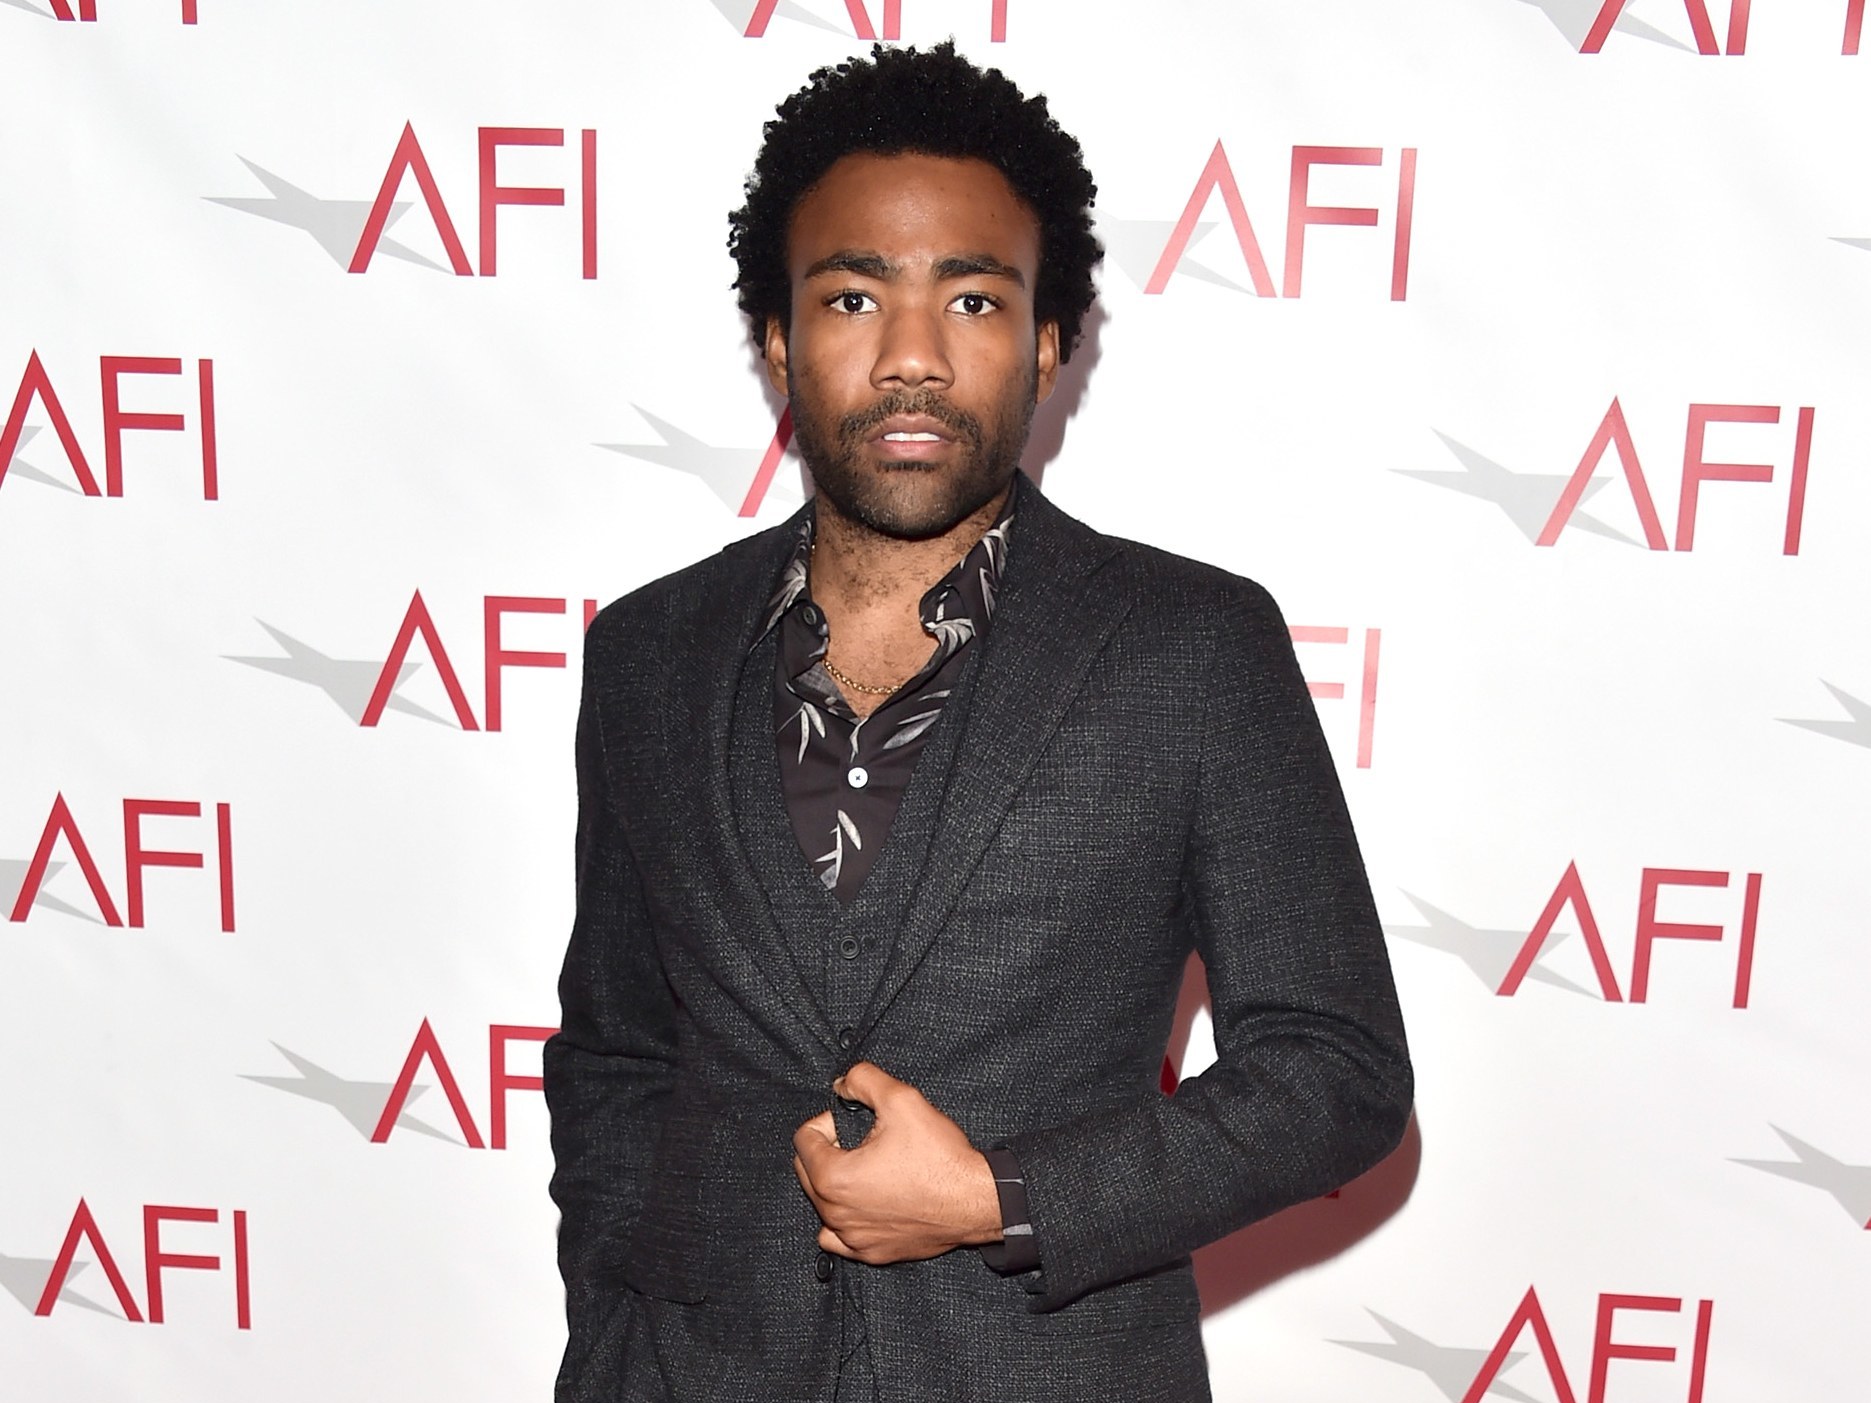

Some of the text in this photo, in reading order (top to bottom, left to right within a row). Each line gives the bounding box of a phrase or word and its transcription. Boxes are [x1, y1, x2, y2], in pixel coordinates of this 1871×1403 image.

[347, 120, 598, 280] AFI
[1143, 138, 1418, 302] AFI
[0, 348, 219, 502] AFI
[1535, 396, 1815, 557] AFI
[359, 588, 598, 733] AF
[9, 791, 236, 934] AFI
[1495, 860, 1764, 1010] AFI
[370, 1016, 562, 1151] AF
[33, 1196, 252, 1331] AFI
